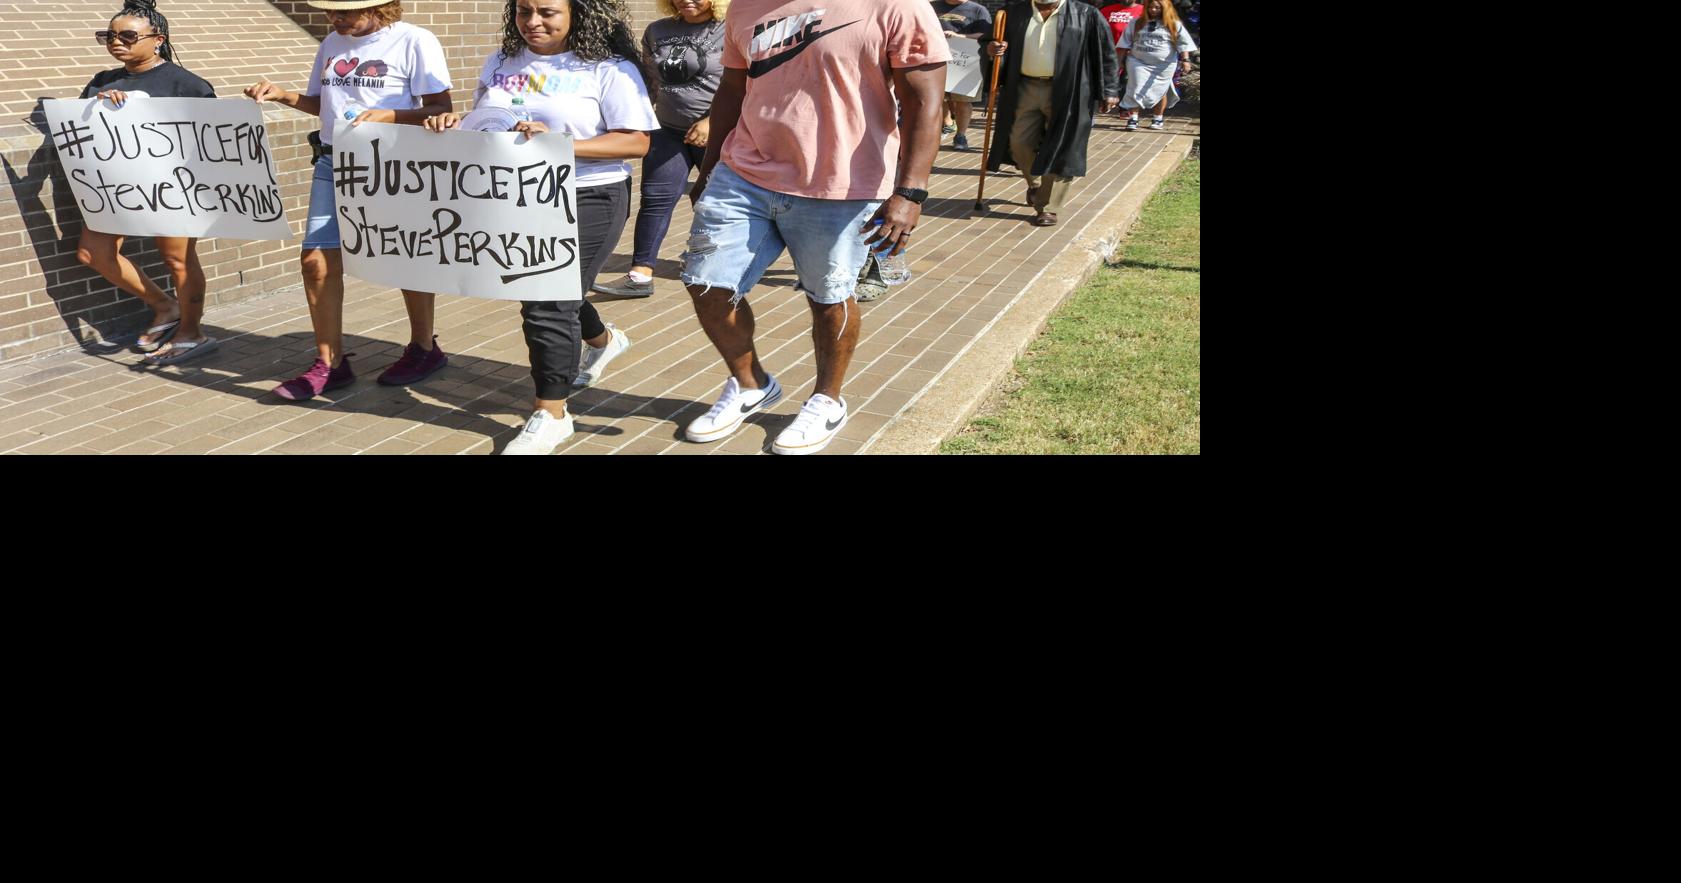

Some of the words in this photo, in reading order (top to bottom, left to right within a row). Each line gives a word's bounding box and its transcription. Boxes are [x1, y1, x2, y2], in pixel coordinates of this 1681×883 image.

[751, 8, 827, 58] NIKE
[332, 77, 351, 87] LOVE
[353, 77, 385, 88] MELANIN
